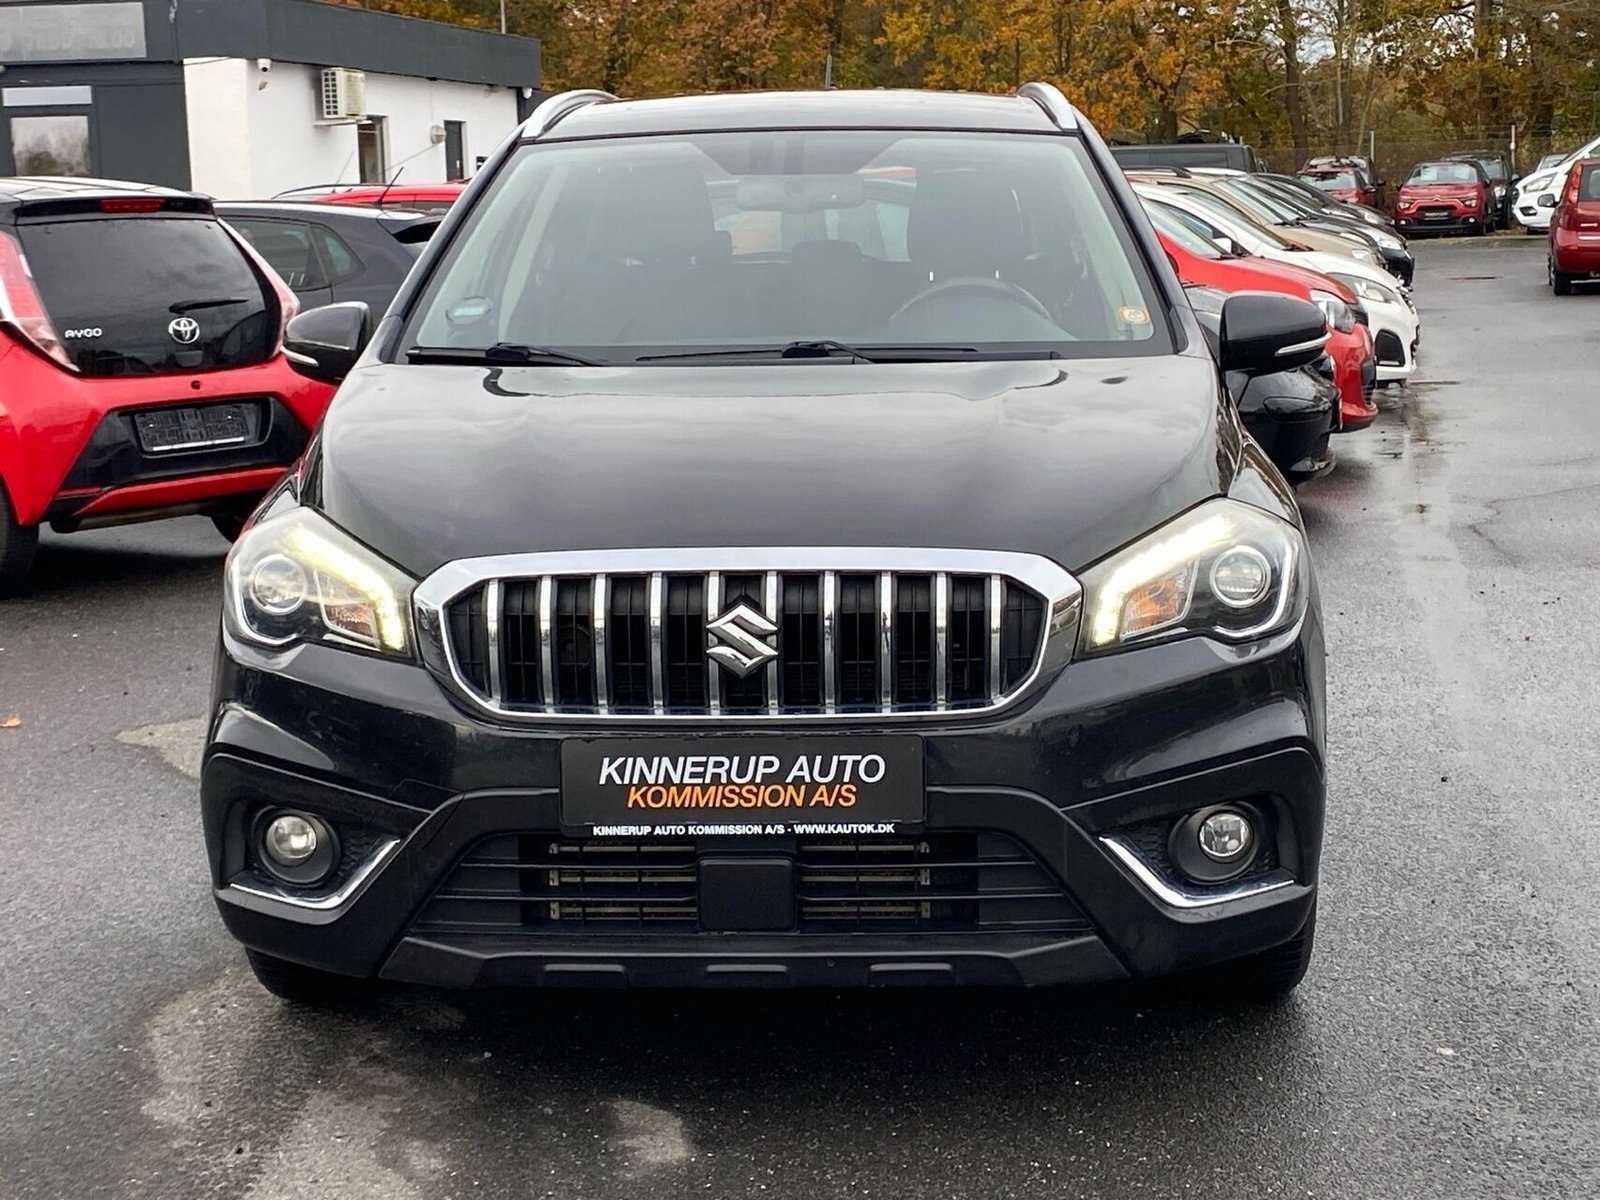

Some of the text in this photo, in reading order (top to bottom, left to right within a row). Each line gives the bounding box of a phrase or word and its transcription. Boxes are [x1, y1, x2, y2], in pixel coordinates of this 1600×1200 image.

[65, 328, 102, 339] AYGO
[599, 754, 886, 786] KINNERUP AUTO
[627, 785, 858, 808] KOMMISSION A/S
[592, 825, 652, 836] KINNERUP
[653, 825, 686, 835] AUTO
[688, 824, 763, 835] KOMMISSION
[764, 824, 785, 835] A/S
[794, 823, 895, 834] WWW.KAUTOK.DK
